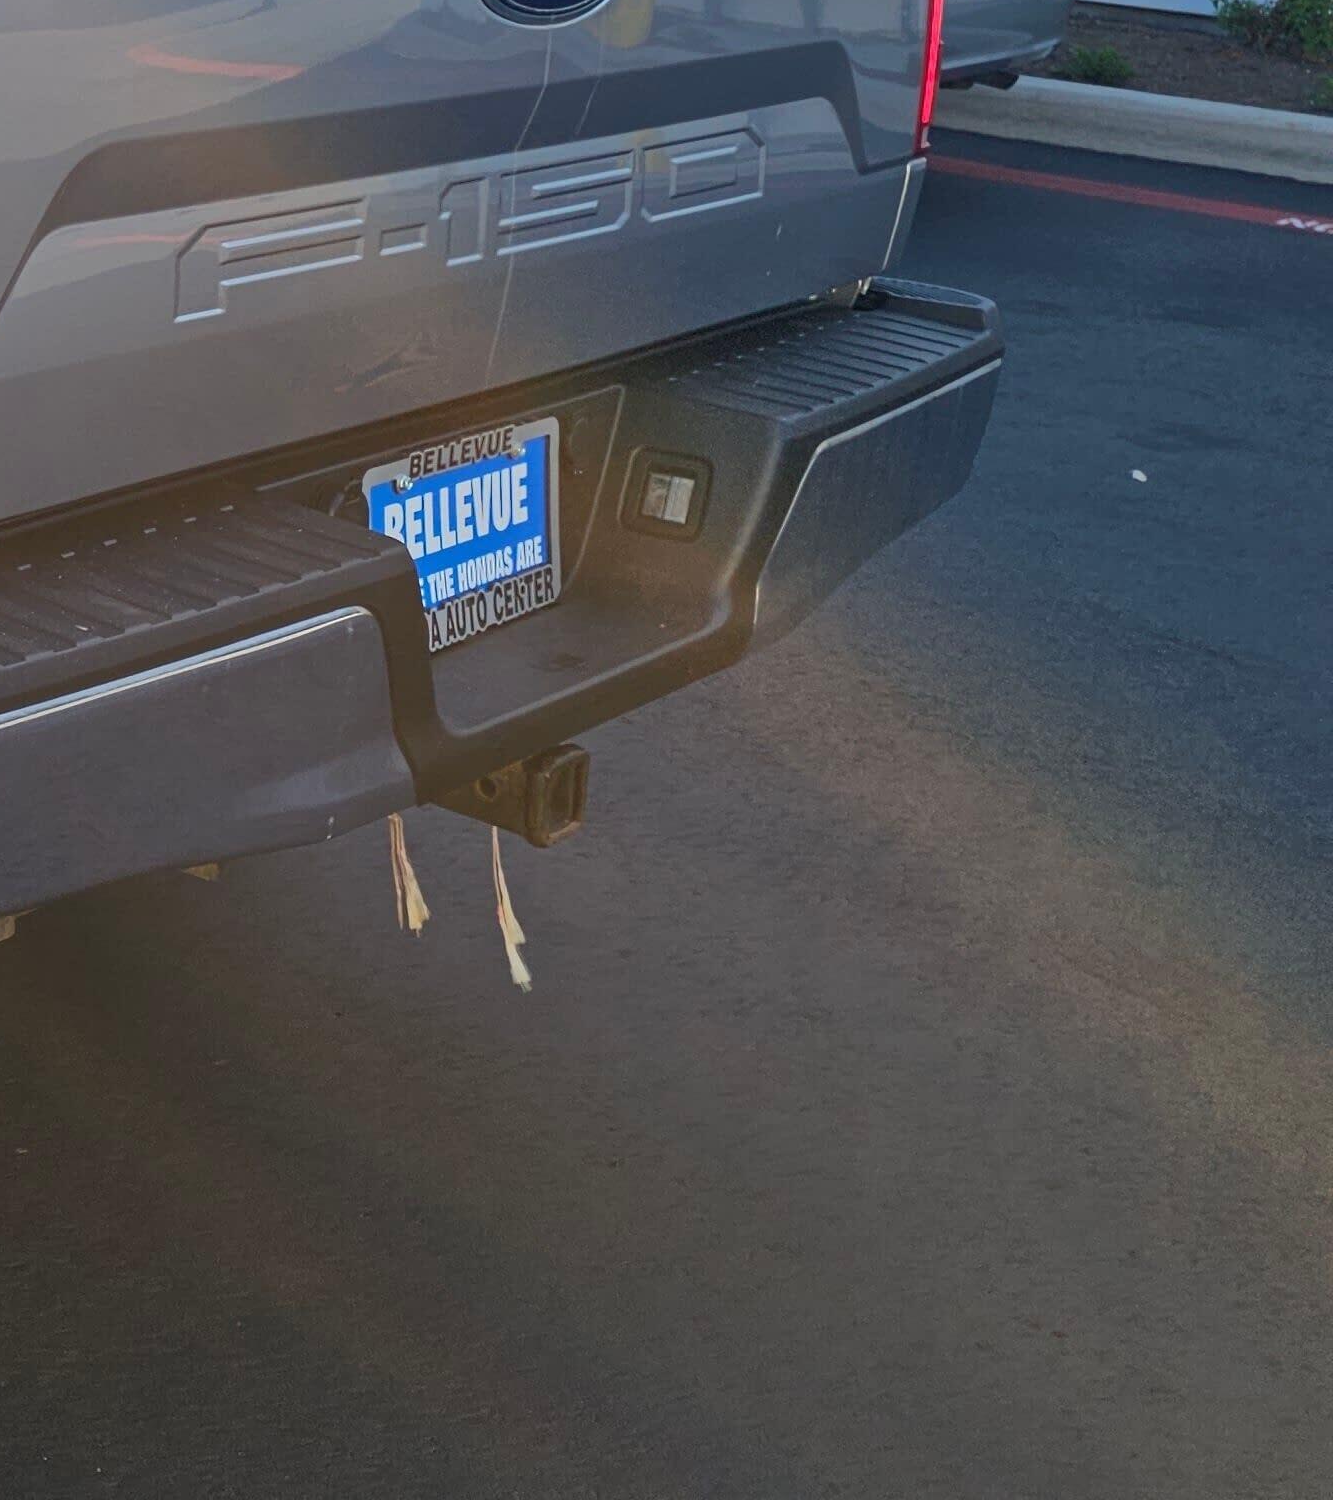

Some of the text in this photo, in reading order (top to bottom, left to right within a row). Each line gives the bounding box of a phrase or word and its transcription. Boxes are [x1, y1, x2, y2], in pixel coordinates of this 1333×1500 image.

[173, 126, 767, 324] F-150
[409, 427, 514, 478] BELLEVUE
[383, 462, 530, 560] BELLEVUE
[427, 567, 456, 604] THE
[457, 545, 514, 593] HONDAS
[516, 534, 544, 572] ARE
[445, 592, 488, 642] AUTO
[493, 566, 556, 622] CENTER
